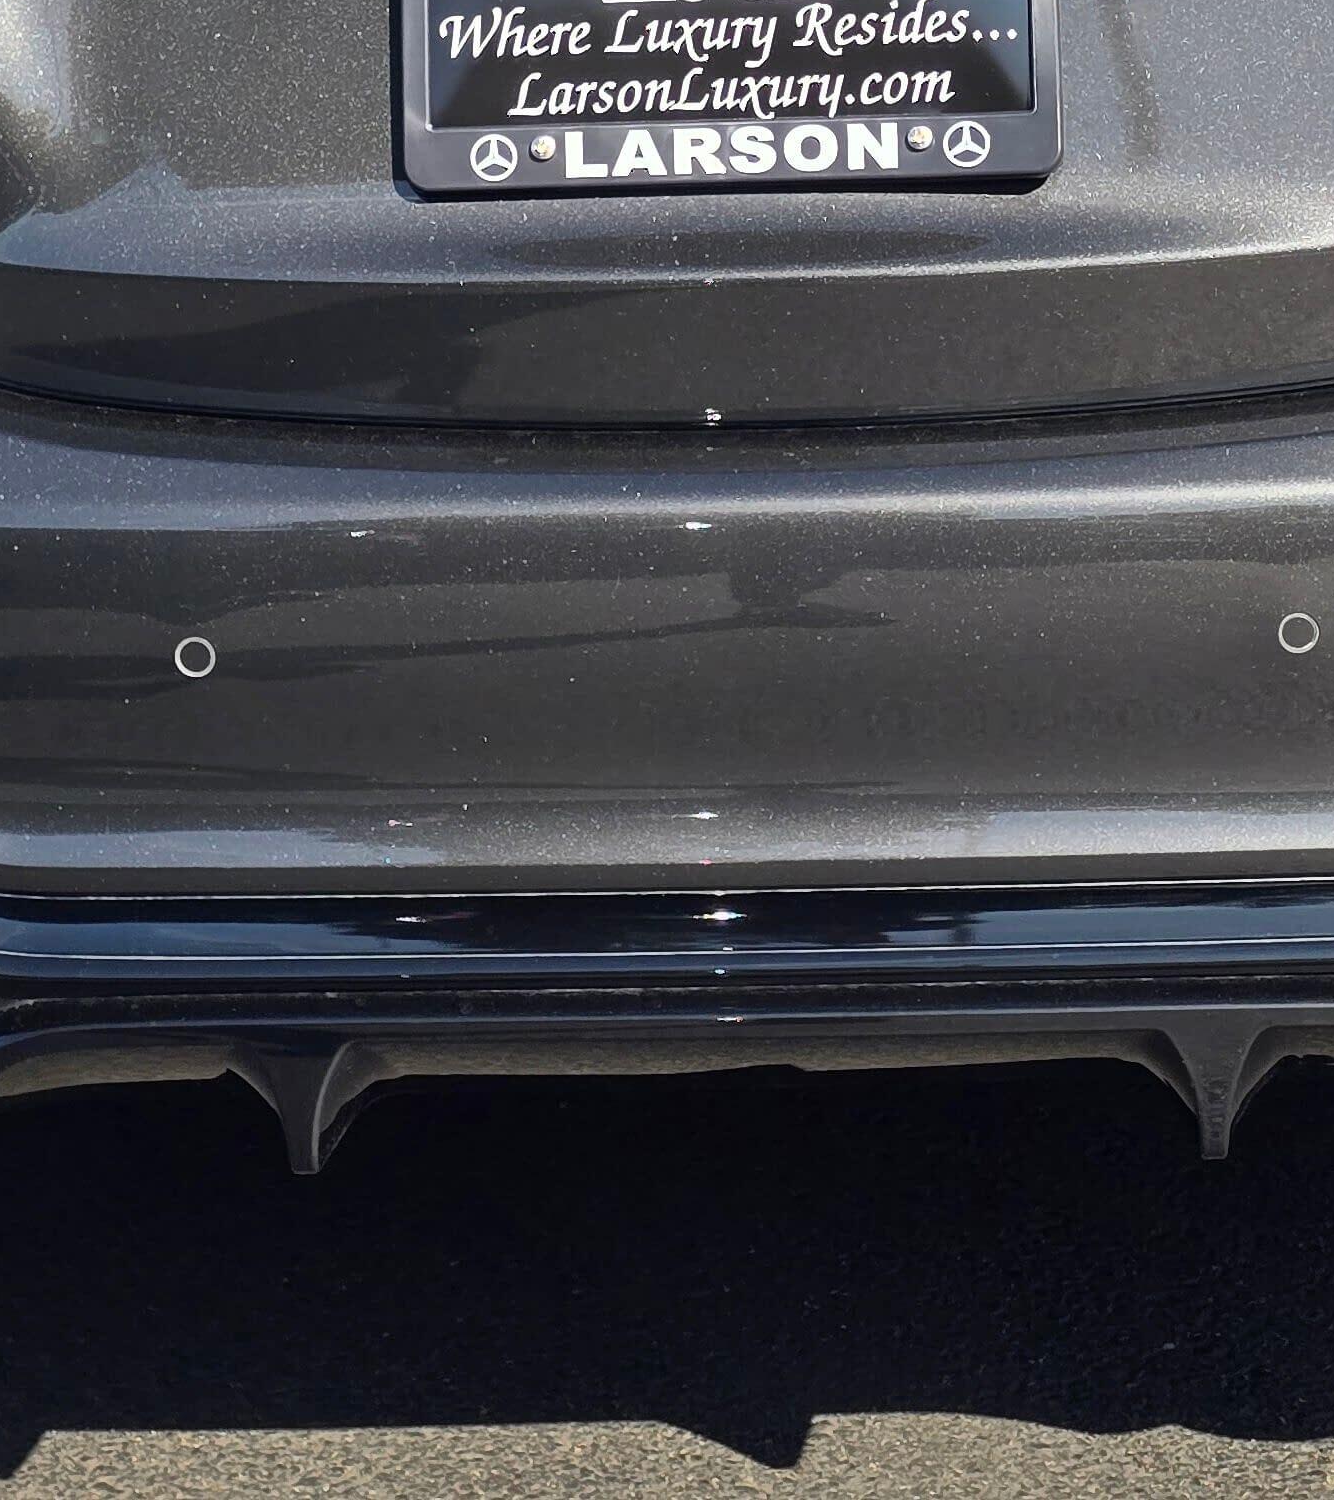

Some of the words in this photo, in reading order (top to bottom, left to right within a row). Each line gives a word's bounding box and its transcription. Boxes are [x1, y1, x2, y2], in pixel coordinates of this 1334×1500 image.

[439, 6, 592, 59] Where
[603, 8, 778, 69] Luxury
[506, 66, 956, 120] LarsonLuxury.com
[564, 121, 900, 179] LARSON
